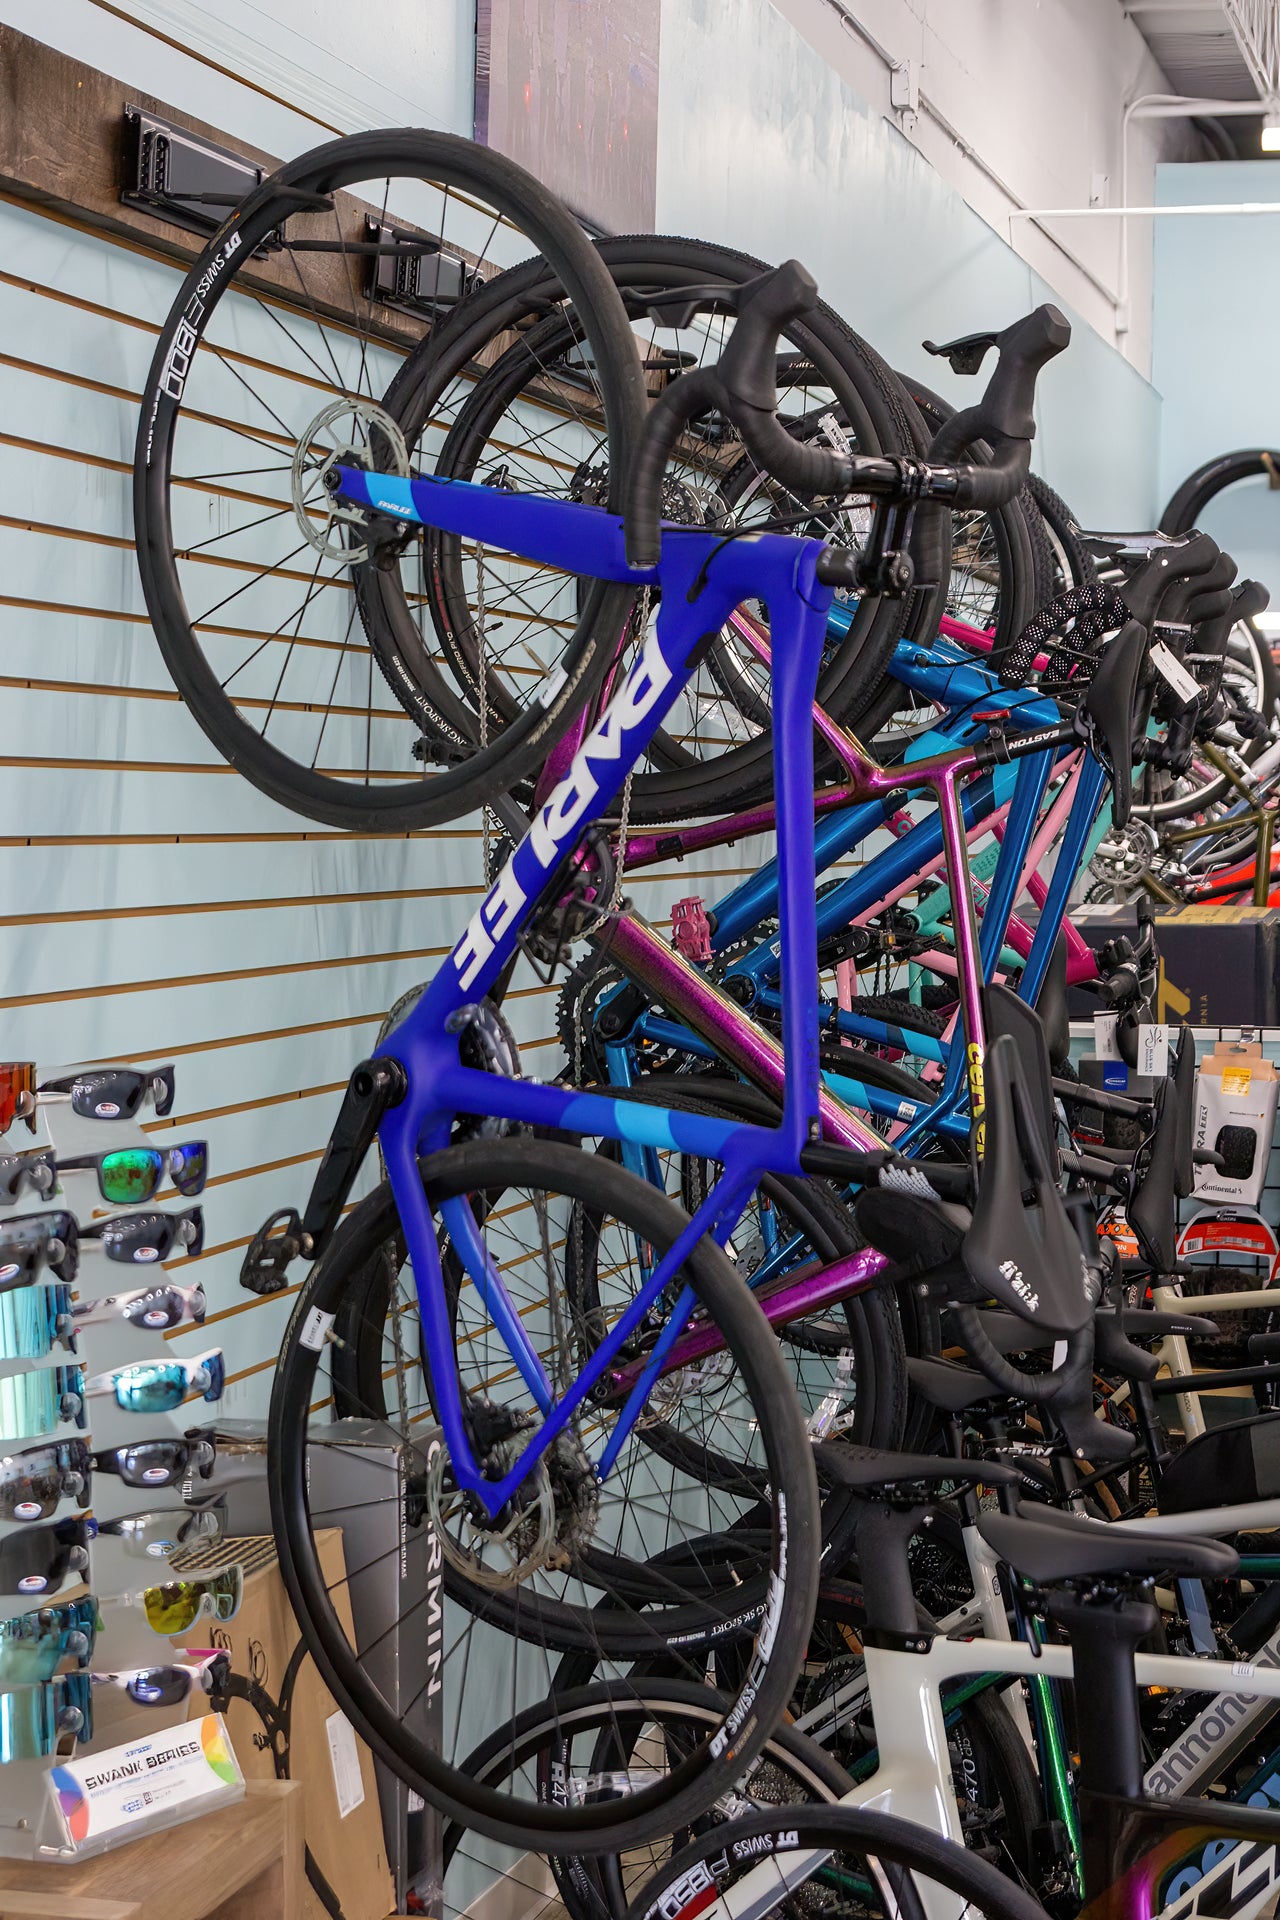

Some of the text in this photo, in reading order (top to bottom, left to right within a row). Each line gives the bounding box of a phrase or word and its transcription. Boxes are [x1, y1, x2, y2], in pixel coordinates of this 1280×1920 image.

[224, 231, 243, 259] DT
[196, 253, 226, 298] SWISS
[414, 695, 441, 723] SPORT
[1008, 729, 1060, 750] EASTON
[453, 620, 674, 992] PARLEE
[427, 1440, 443, 1697] GRMIN
[85, 1760, 143, 1790] SWANK
[732, 1833, 774, 1859] SWISS
[776, 1830, 800, 1848] DT
